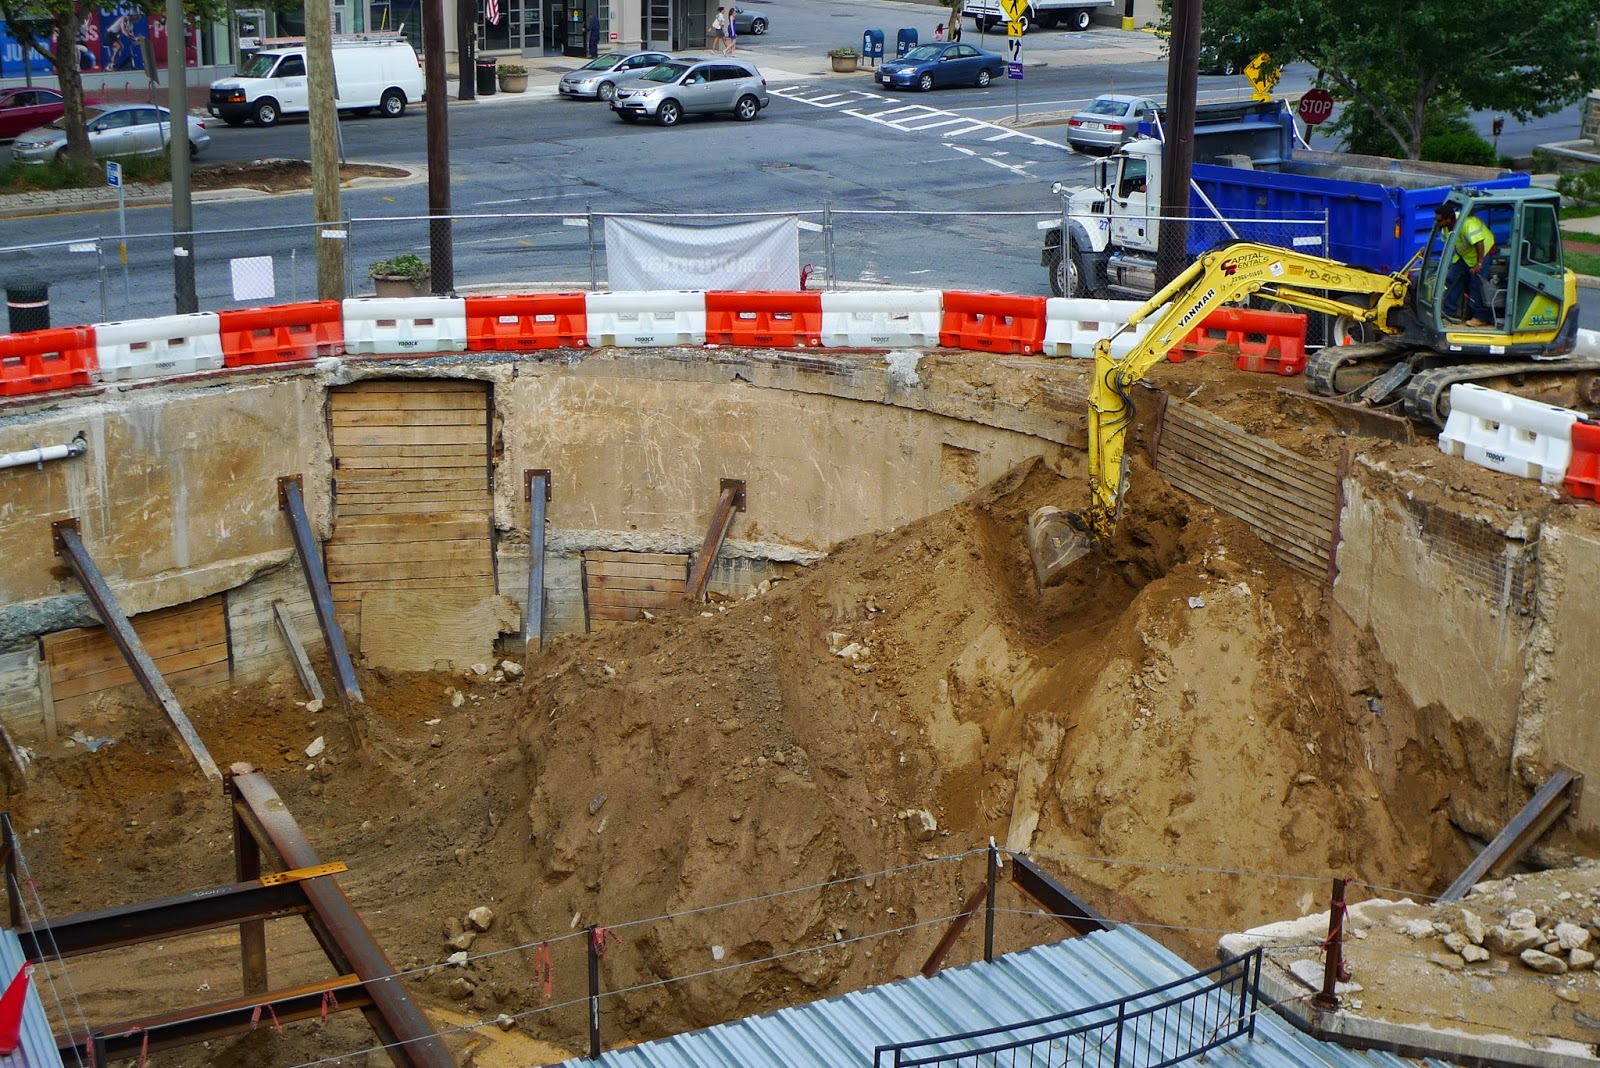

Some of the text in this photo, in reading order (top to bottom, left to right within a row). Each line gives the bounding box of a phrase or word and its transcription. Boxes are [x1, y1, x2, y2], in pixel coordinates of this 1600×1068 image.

[1301, 99, 1331, 114] STOP
[1099, 220, 1108, 231] 27
[1221, 252, 1263, 270] CAPITAL
[1178, 289, 1215, 327] YANMAR
[1485, 451, 1505, 463] YODOCK
